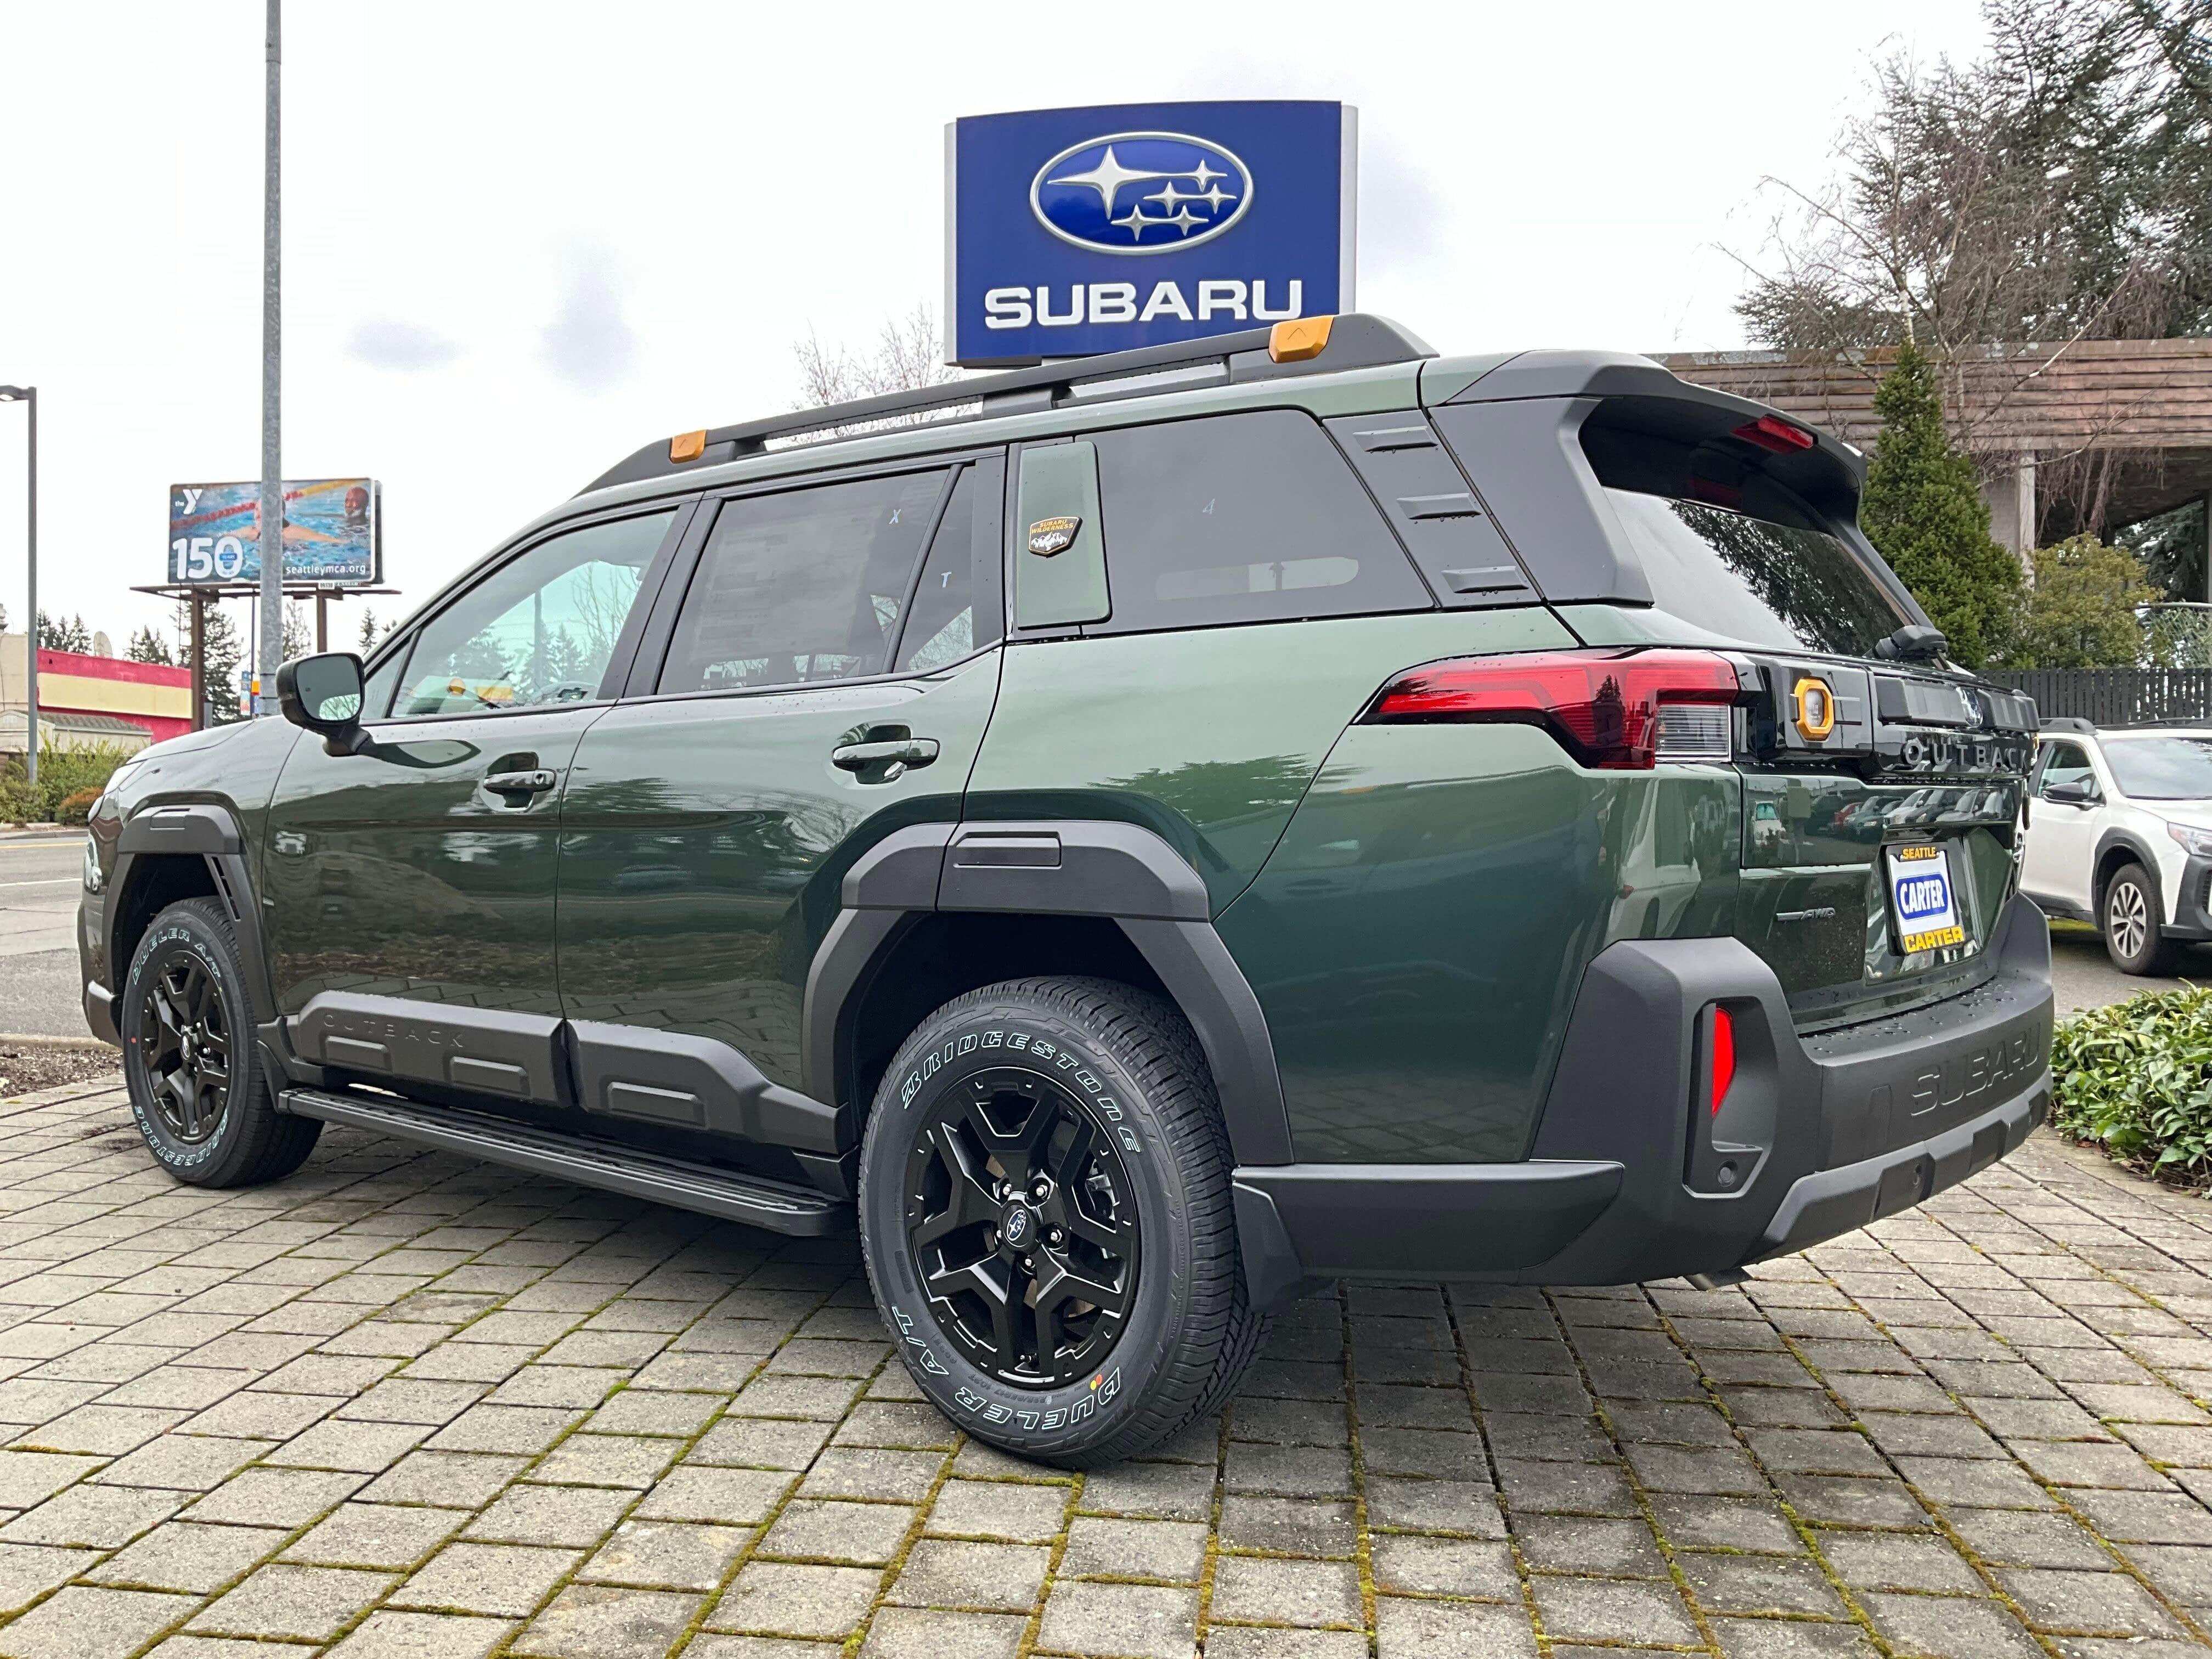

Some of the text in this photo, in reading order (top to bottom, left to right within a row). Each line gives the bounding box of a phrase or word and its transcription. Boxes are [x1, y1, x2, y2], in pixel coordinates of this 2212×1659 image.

[985, 280, 1302, 329] SUBARU
[1031, 523, 1073, 534] WILDERNESS
[1040, 519, 1067, 527] SUBARU
[172, 536, 243, 579] 150
[285, 565, 365, 576] seattleymca.org
[1901, 738, 2027, 769] OUTBACK
[1903, 847, 1936, 859] SEATTLE
[1900, 879, 1945, 914] CARTER
[132, 928, 221, 985] DUELER A/T
[1904, 926, 1965, 953] CARTER
[1911, 1022, 2040, 1116] SUBARU
[901, 1031, 1141, 1152] BRIDGESTONE
[134, 1106, 228, 1166] BRIDGESTONE
[891, 1306, 949, 1375] A/T
[955, 1367, 1120, 1430] DUELER
